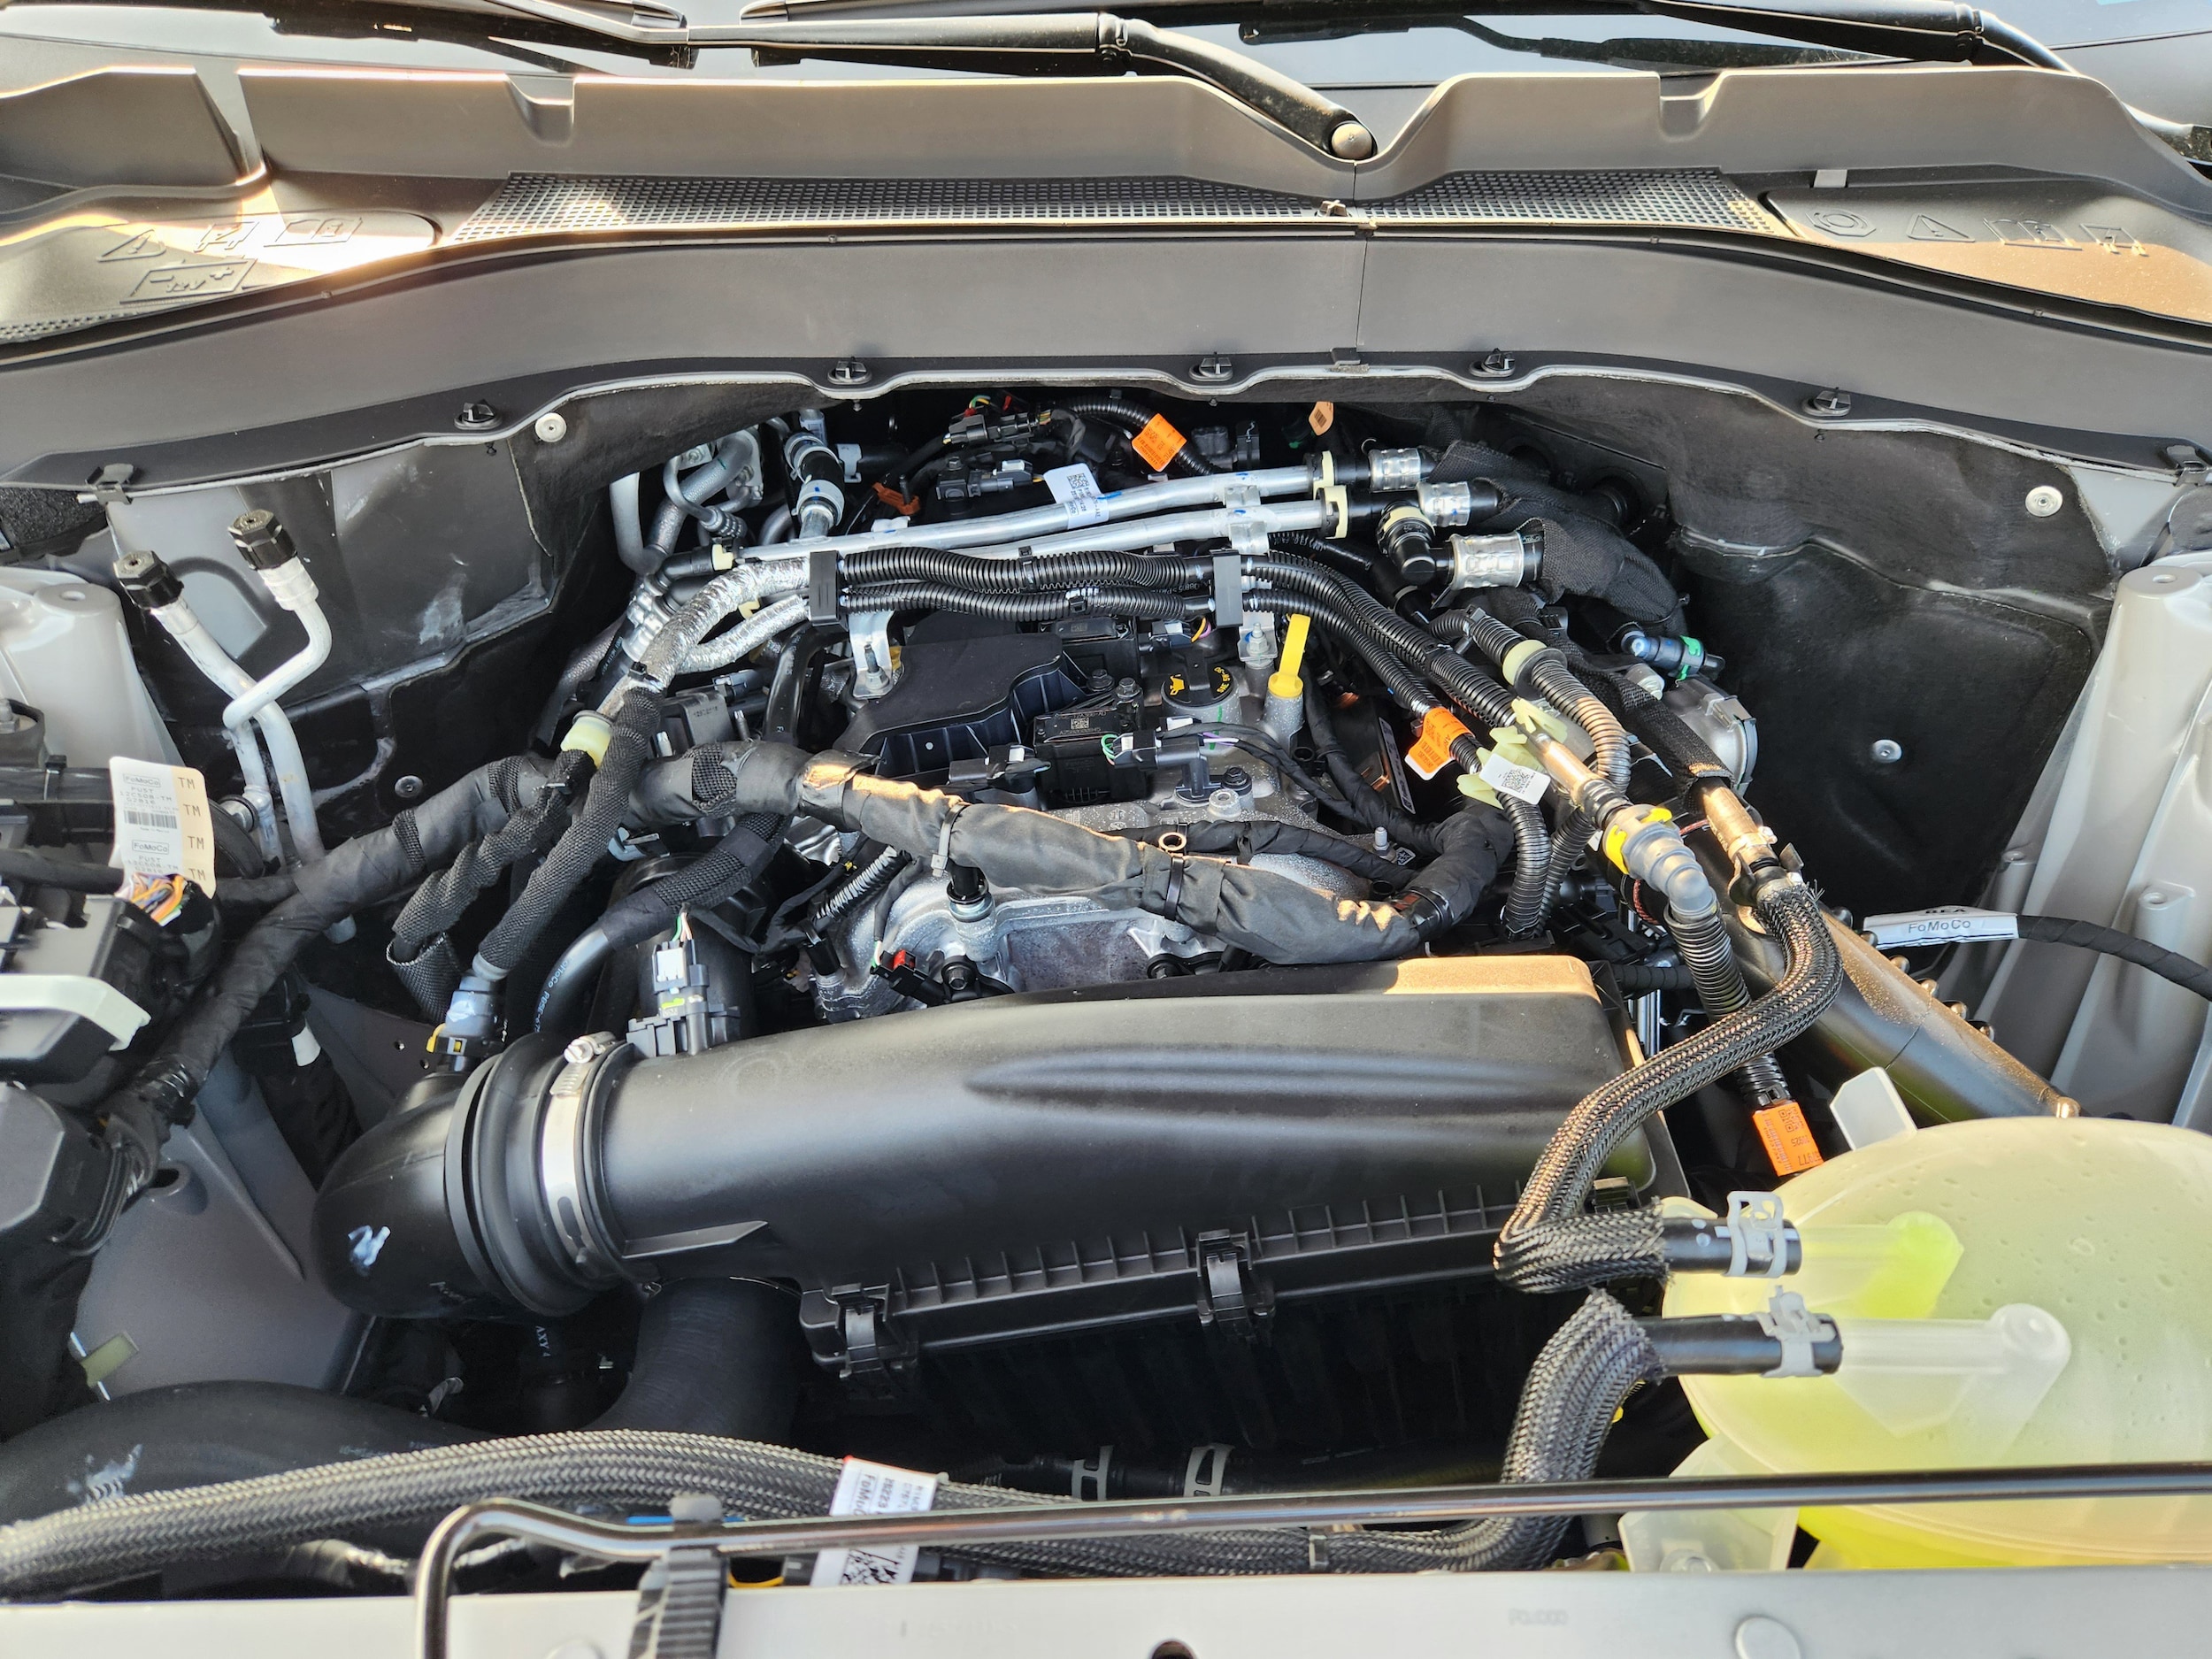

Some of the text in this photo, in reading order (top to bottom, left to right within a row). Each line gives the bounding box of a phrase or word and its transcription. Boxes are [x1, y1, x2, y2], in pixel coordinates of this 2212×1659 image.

[125, 776, 196, 790] FoMoCo TM
[183, 803, 201, 817] TM
[133, 841, 169, 853] FoMoCo
[188, 835, 204, 850] TM
[188, 868, 207, 881] TM
[1908, 918, 1971, 934] FoMoCo
[852, 1472, 876, 1516] FoMoC
